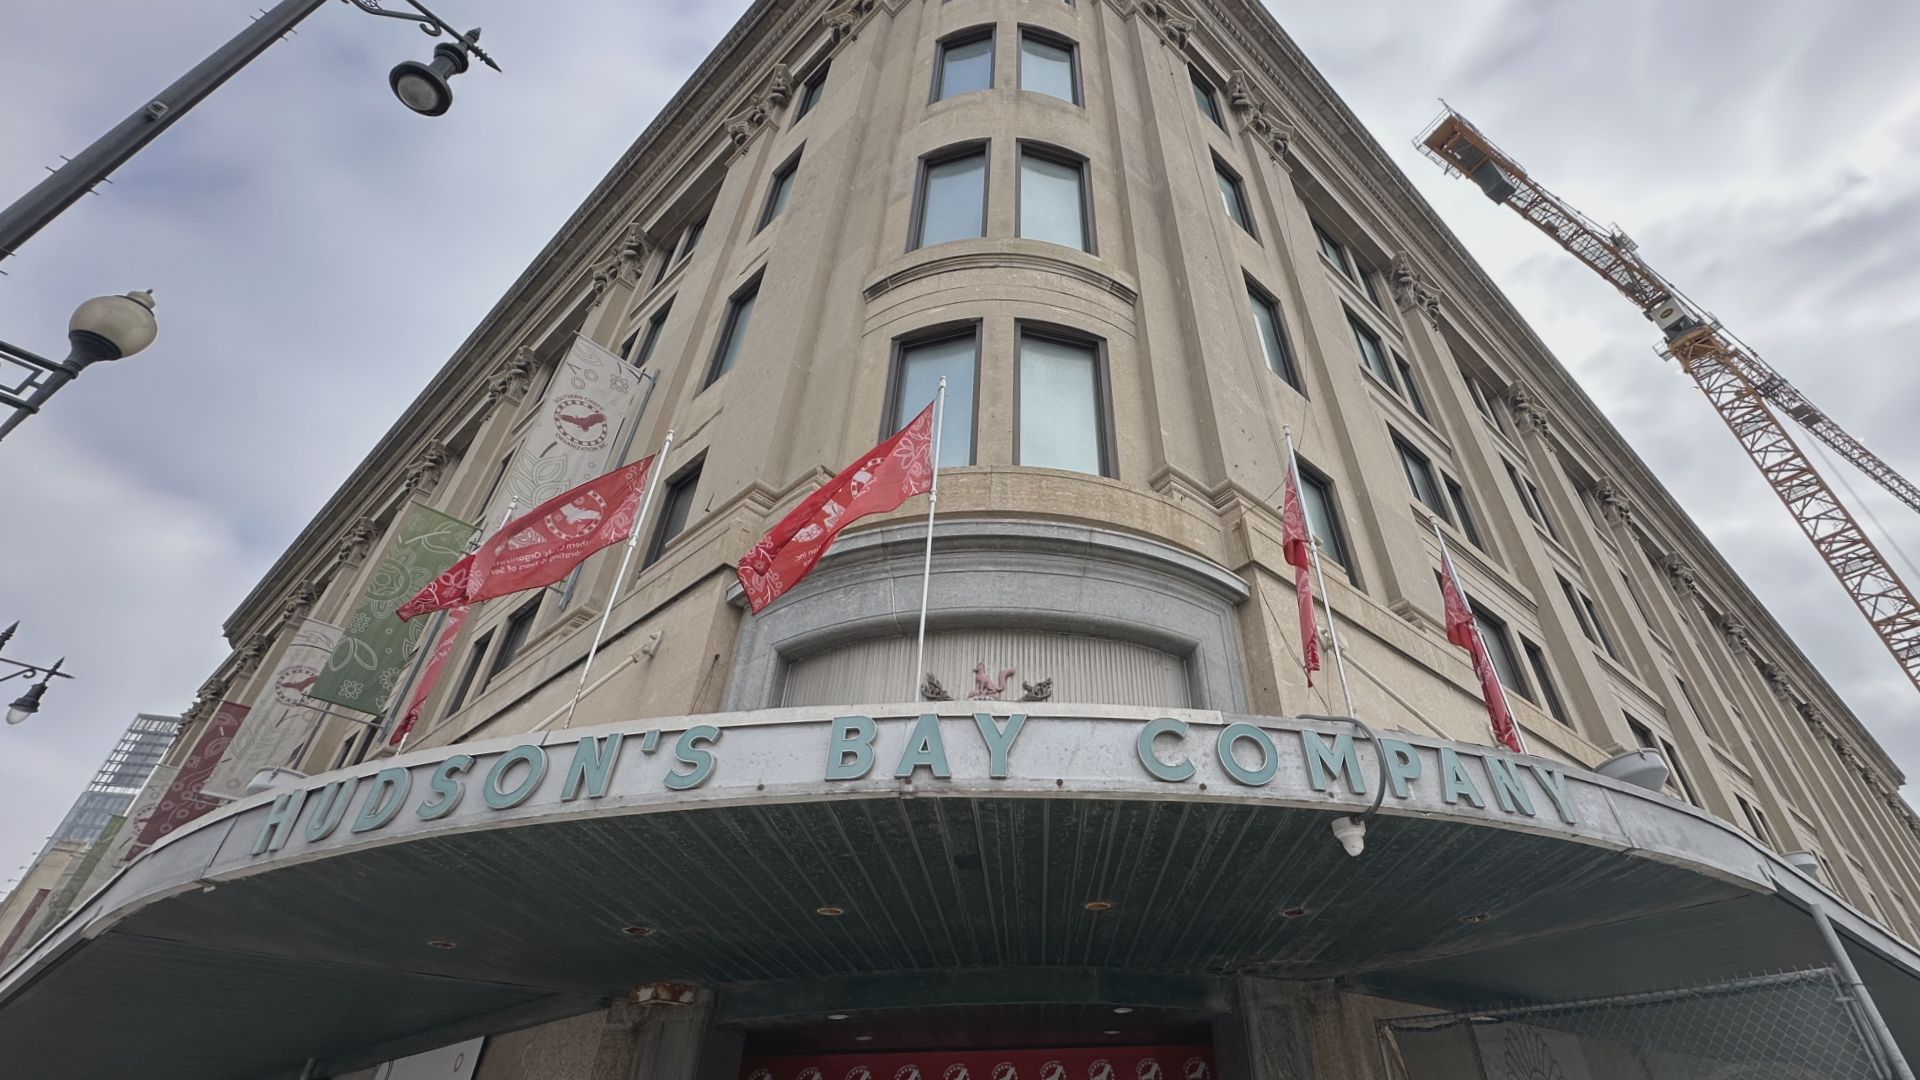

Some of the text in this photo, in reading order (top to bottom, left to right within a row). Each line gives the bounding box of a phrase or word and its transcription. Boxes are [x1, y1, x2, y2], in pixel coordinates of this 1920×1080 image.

[250, 713, 1577, 856] HUDSON'S BAY COMPANY
